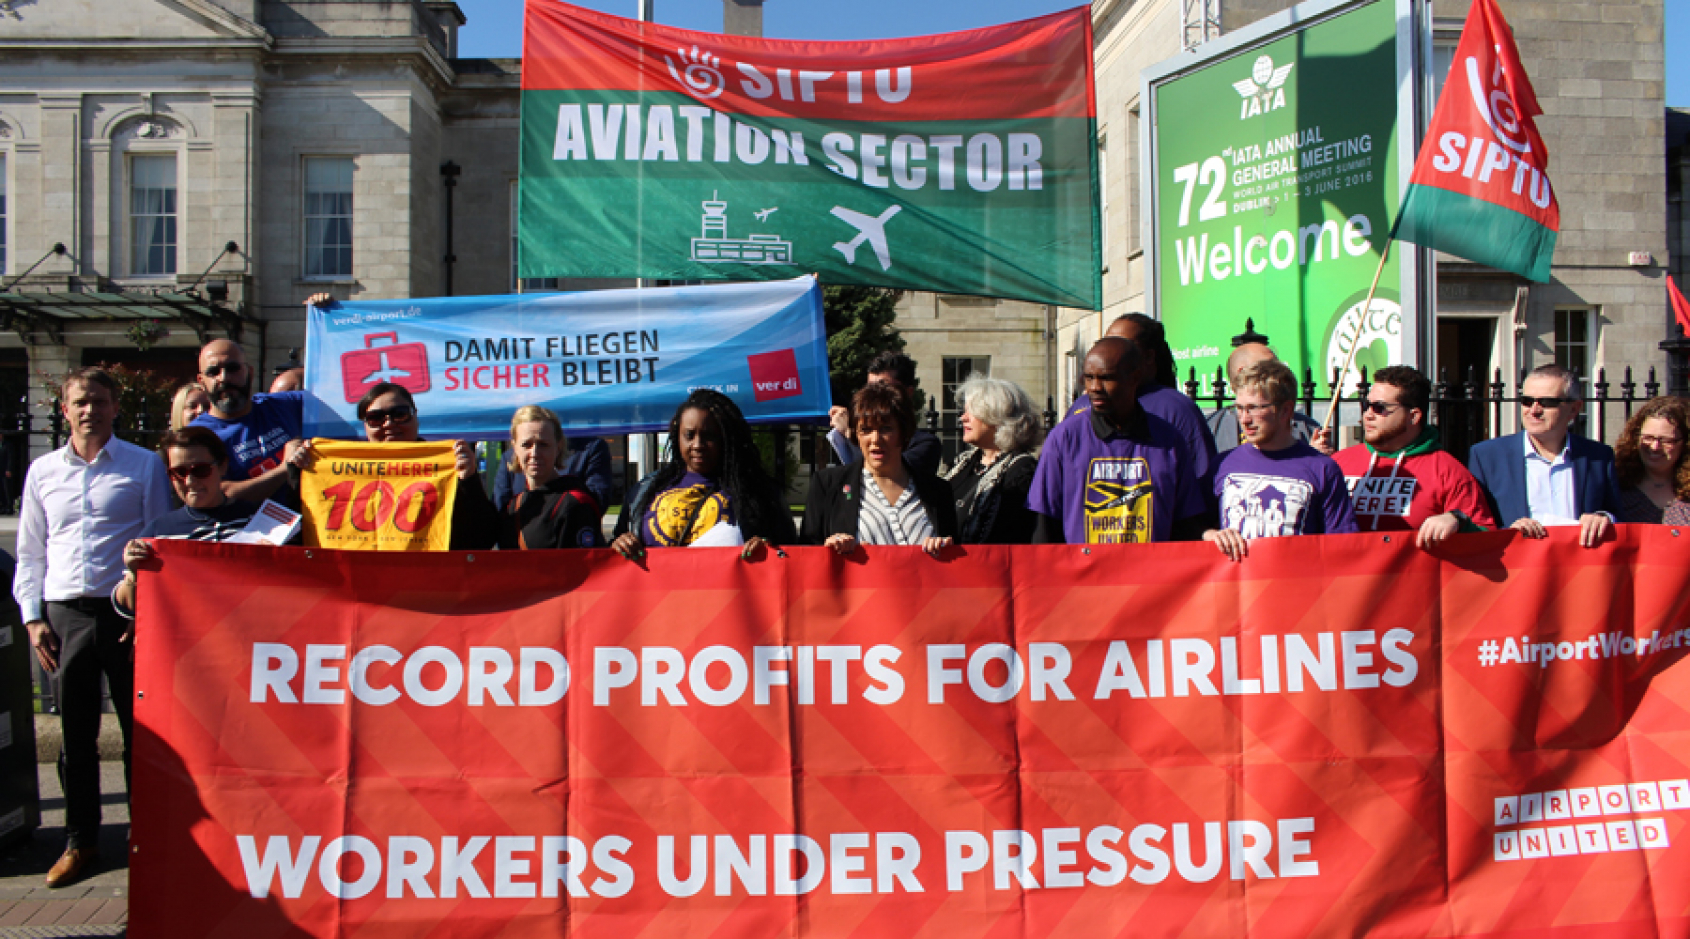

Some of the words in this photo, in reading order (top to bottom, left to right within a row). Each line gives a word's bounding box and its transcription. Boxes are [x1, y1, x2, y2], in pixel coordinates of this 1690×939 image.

[1240, 87, 1286, 120] IATA
[552, 104, 809, 165] AVIATION
[822, 132, 1043, 192] SECTOR
[1232, 155, 1298, 186] GENERAL
[1301, 134, 1372, 169] MEETING
[1233, 144, 1262, 166] IATA
[1265, 126, 1324, 158] ANNUAL
[1233, 184, 1262, 199] WORLD
[1266, 180, 1279, 192] AIR
[1282, 166, 1333, 187] TRANSPORT
[1336, 156, 1372, 174] SUMMIT
[1432, 131, 1550, 209] SIPTU
[1233, 196, 1270, 214] DUBLIN
[1305, 186, 1311, 197] 3
[1314, 178, 1341, 195] JUNE
[1346, 170, 1373, 188] 2016
[1175, 213, 1372, 286] Welcome
[445, 337, 535, 362] DAMIT
[546, 330, 659, 357] FLIEGEN
[1192, 344, 1219, 359] airline
[445, 364, 550, 391] SICHER
[562, 356, 659, 385] BLEIBT
[322, 480, 439, 533] 100
[1355, 496, 1408, 513] ERE!
[250, 642, 570, 706] RECORD
[593, 644, 905, 706] PROFITS
[926, 642, 1075, 704] FOR
[1094, 627, 1418, 699] AIRLINES
[1478, 627, 1690, 668] #AirportWorkers
[1499, 785, 1682, 820] AIRPORT
[236, 835, 634, 898] WORKERS
[657, 832, 924, 896] UNDER
[945, 817, 1319, 891] PRESSURE
[1499, 824, 1660, 856] UNITED
